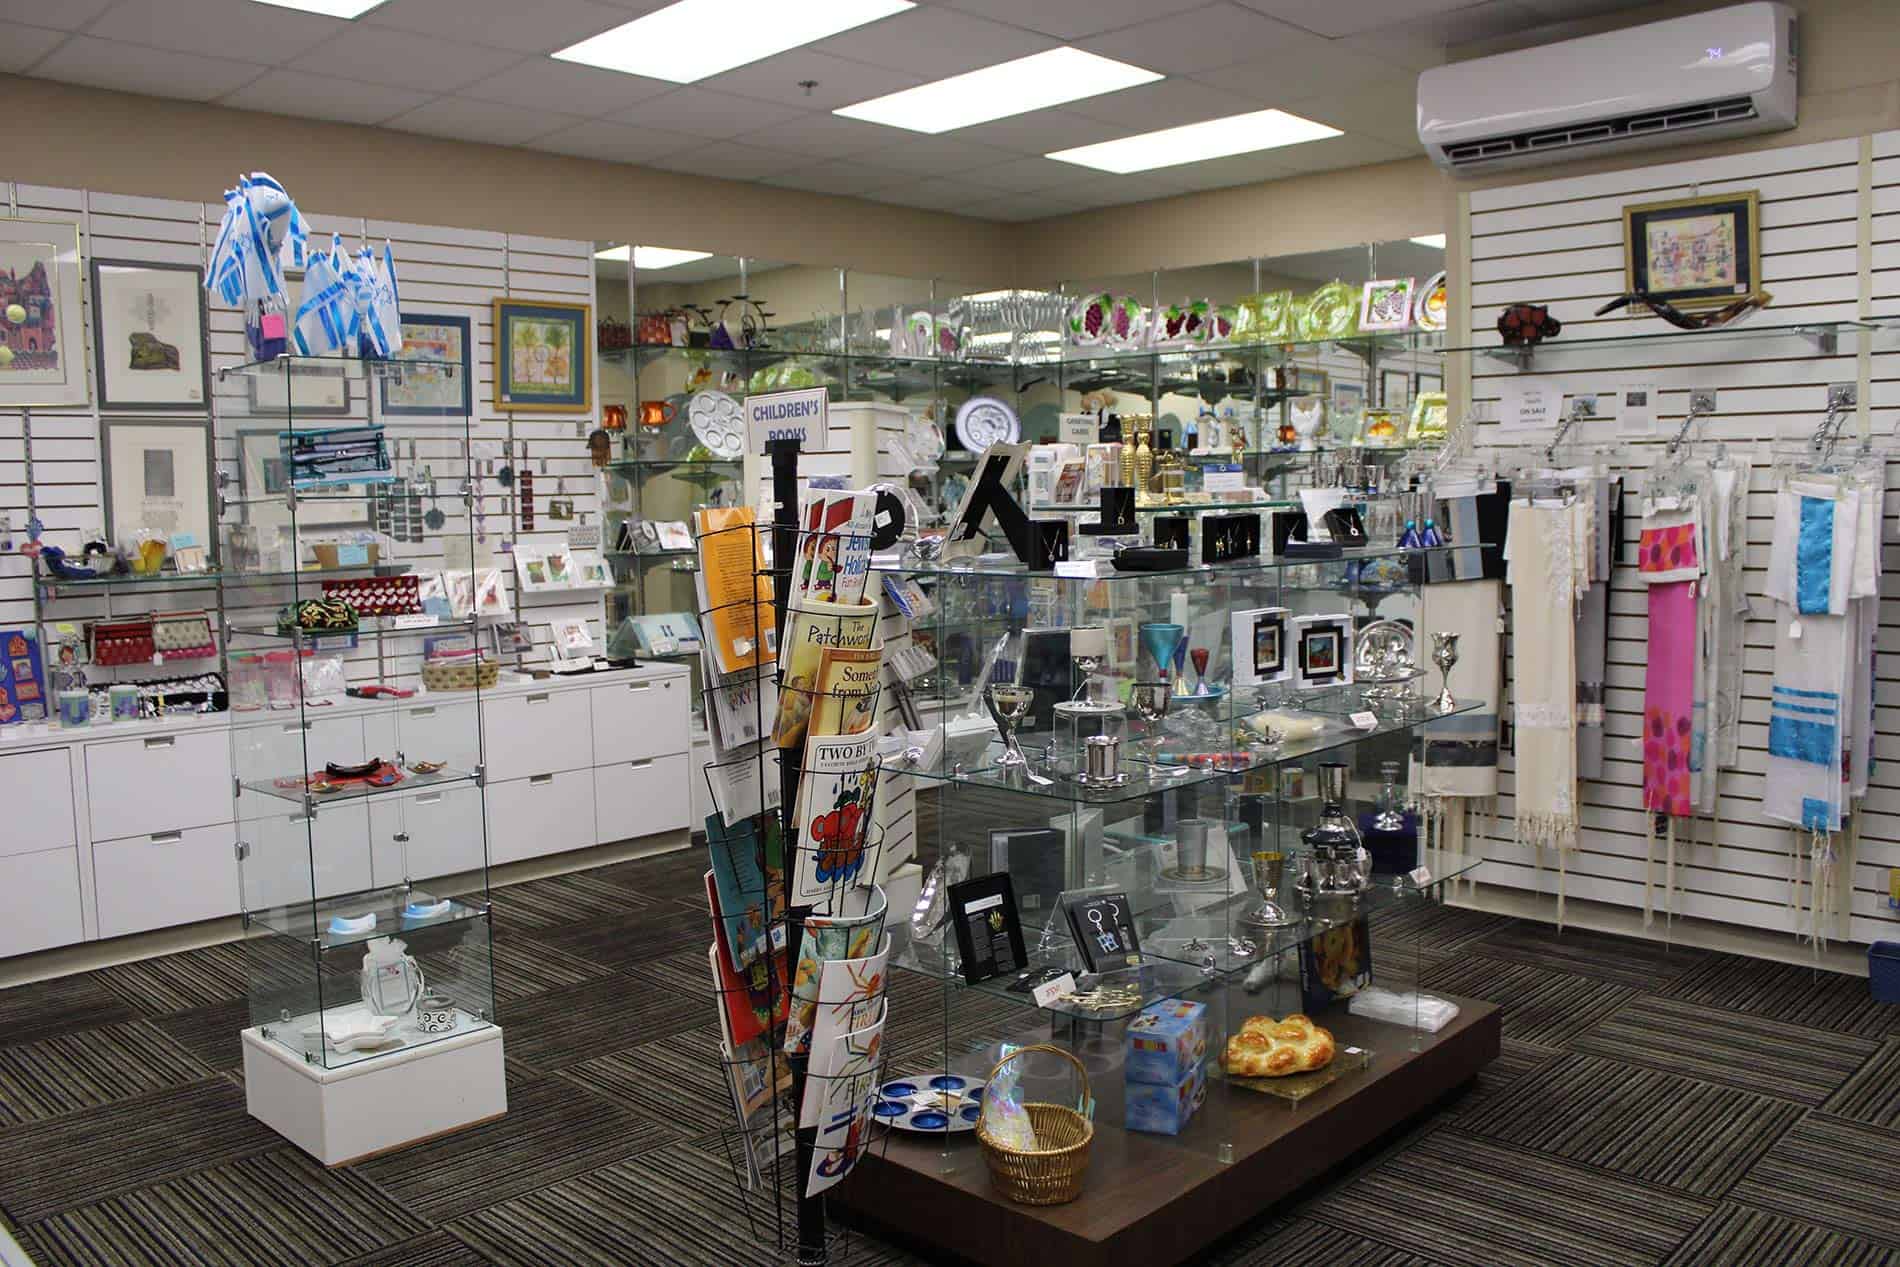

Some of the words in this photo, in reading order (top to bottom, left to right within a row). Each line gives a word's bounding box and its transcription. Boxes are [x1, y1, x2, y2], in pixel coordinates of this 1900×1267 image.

[753, 399, 819, 421] CHILDREN'S
[832, 682, 863, 698] from
[819, 746, 853, 760] TWO
